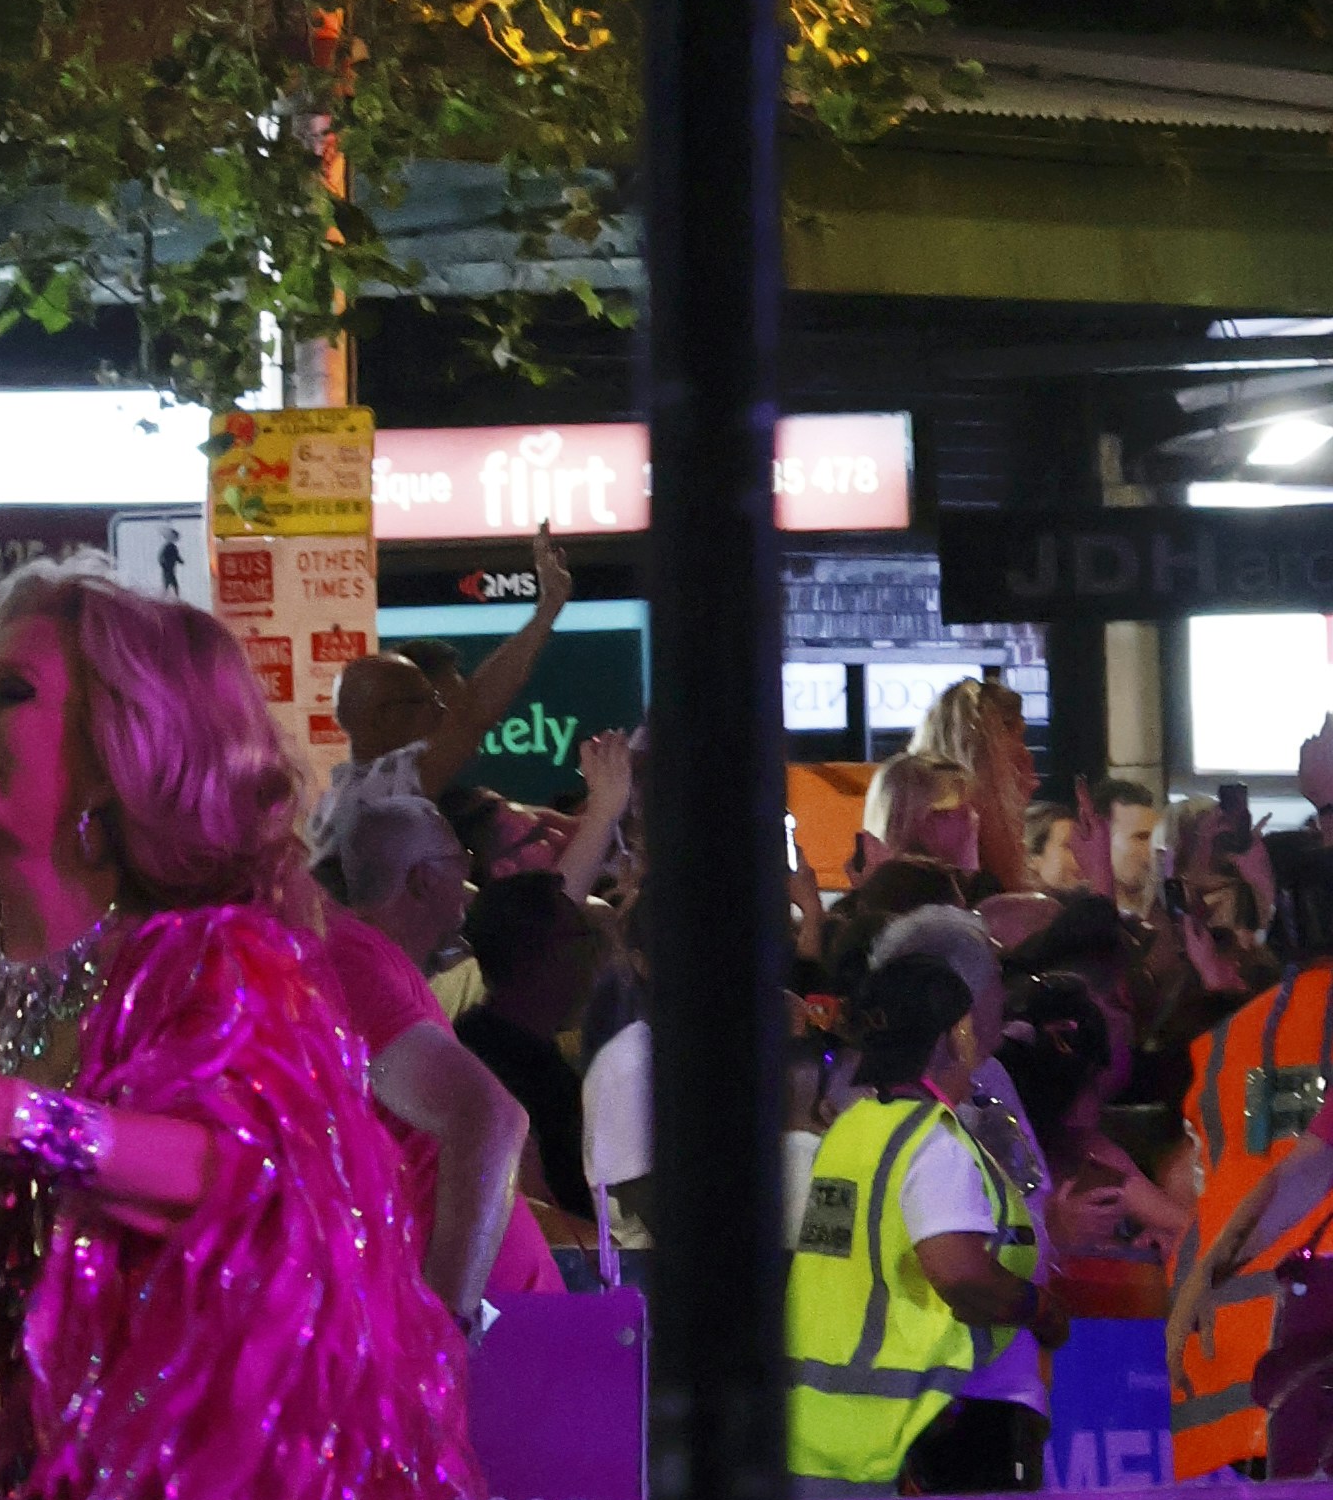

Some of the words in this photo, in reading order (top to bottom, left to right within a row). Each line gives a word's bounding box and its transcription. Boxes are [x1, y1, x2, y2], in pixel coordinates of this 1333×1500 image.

[479, 431, 618, 527] flirt
[811, 455, 879, 495] 478
[296, 548, 367, 574] OTHER
[301, 577, 366, 600] TIMES
